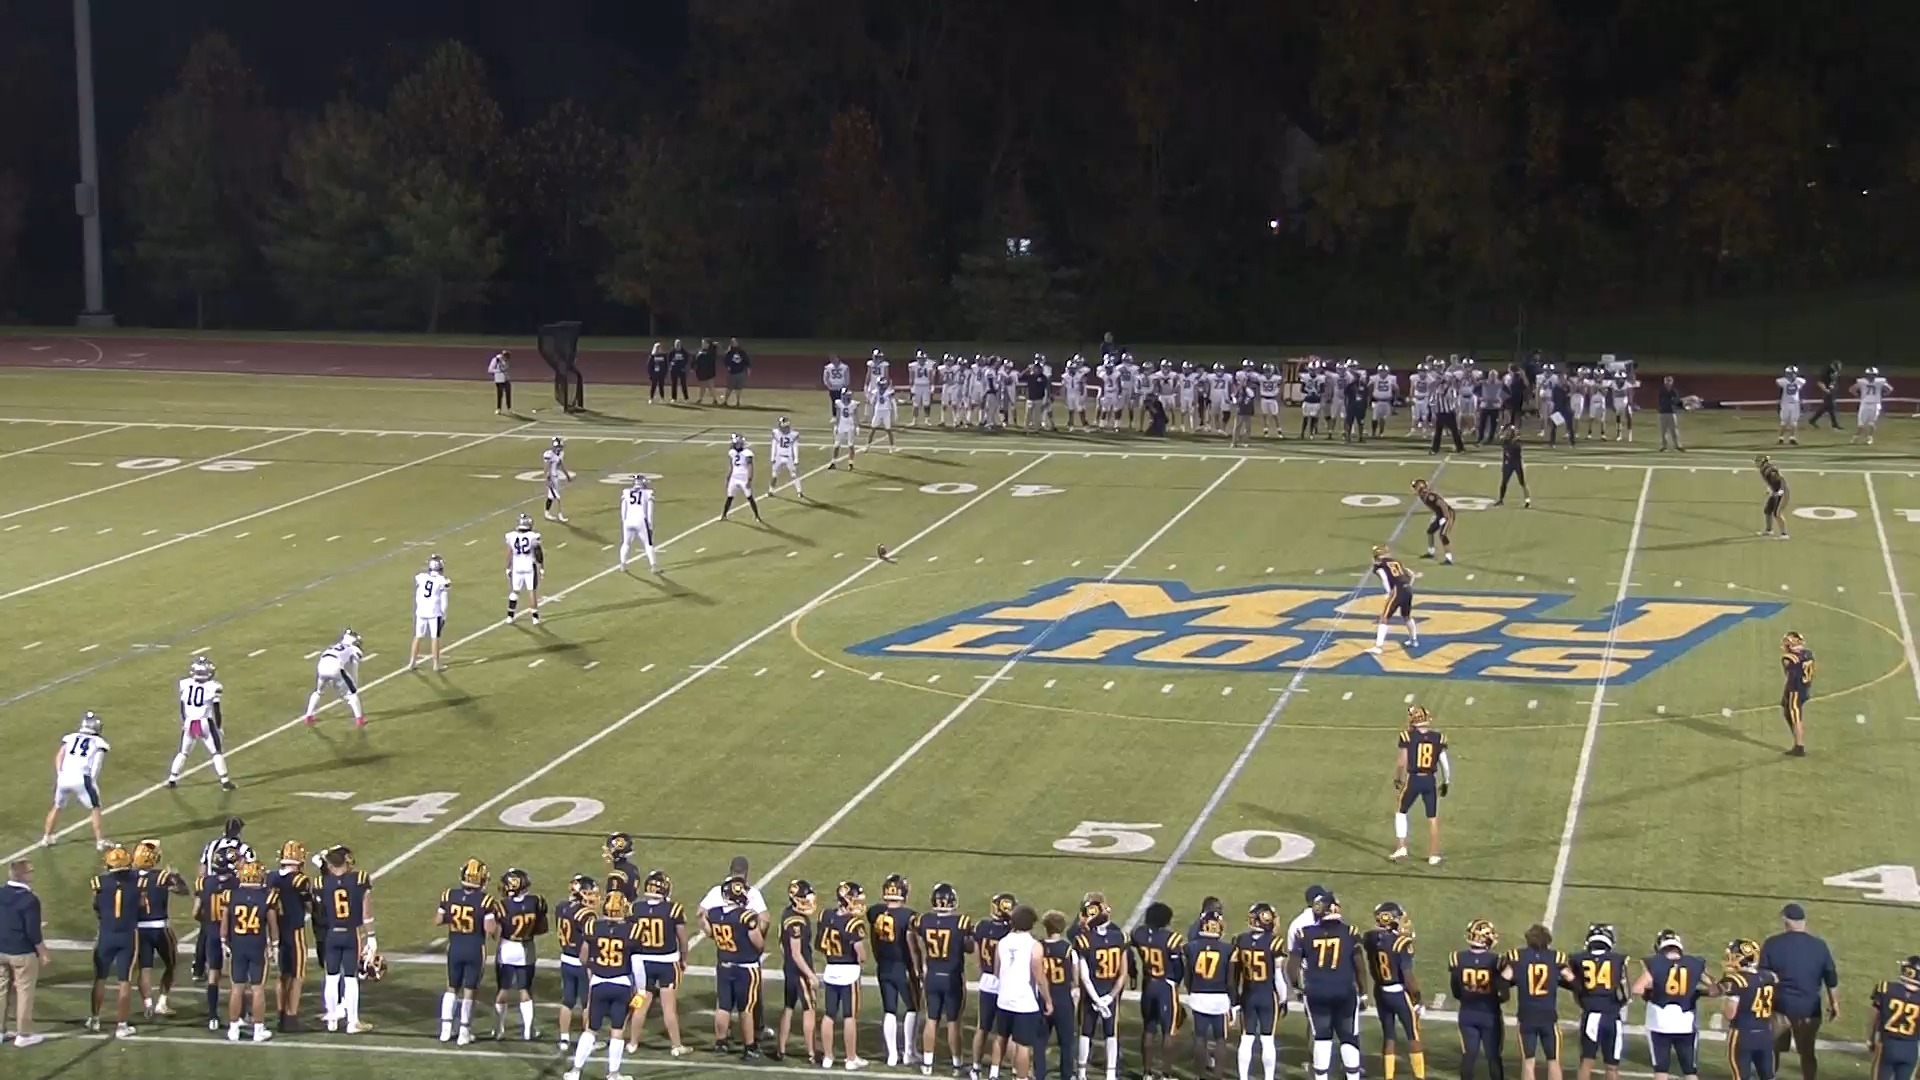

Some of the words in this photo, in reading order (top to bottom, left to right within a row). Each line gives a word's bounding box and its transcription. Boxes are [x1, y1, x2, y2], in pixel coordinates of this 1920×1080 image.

[780, 437, 790, 448] 12
[734, 454, 741, 466] 2
[629, 490, 643, 506] 51
[513, 536, 530, 555] 42
[423, 580, 433, 598] 9
[978, 582, 1754, 642] MSJ
[882, 624, 1655, 679] LIONS
[186, 685, 204, 708] 10
[70, 737, 92, 757] 14
[1417, 742, 1434, 768] 18
[1052, 820, 1315, 864] 50
[114, 889, 122, 918] 1
[334, 888, 349, 918] 6
[450, 903, 475, 933] 35
[234, 904, 260, 935] 34
[510, 913, 536, 940] 27
[596, 937, 624, 967] 36
[712, 923, 738, 952] 68
[820, 926, 843, 957] 45
[926, 928, 951, 958] 57
[1095, 947, 1121, 979] 30
[1195, 950, 1221, 979] 47
[1313, 938, 1341, 969] 77
[1378, 951, 1393, 981] 8
[1527, 963, 1549, 996] 12
[1581, 959, 1612, 990] 34
[1664, 966, 1689, 996] 61
[1751, 985, 1774, 1019] 43
[1884, 999, 1919, 1036] 23
